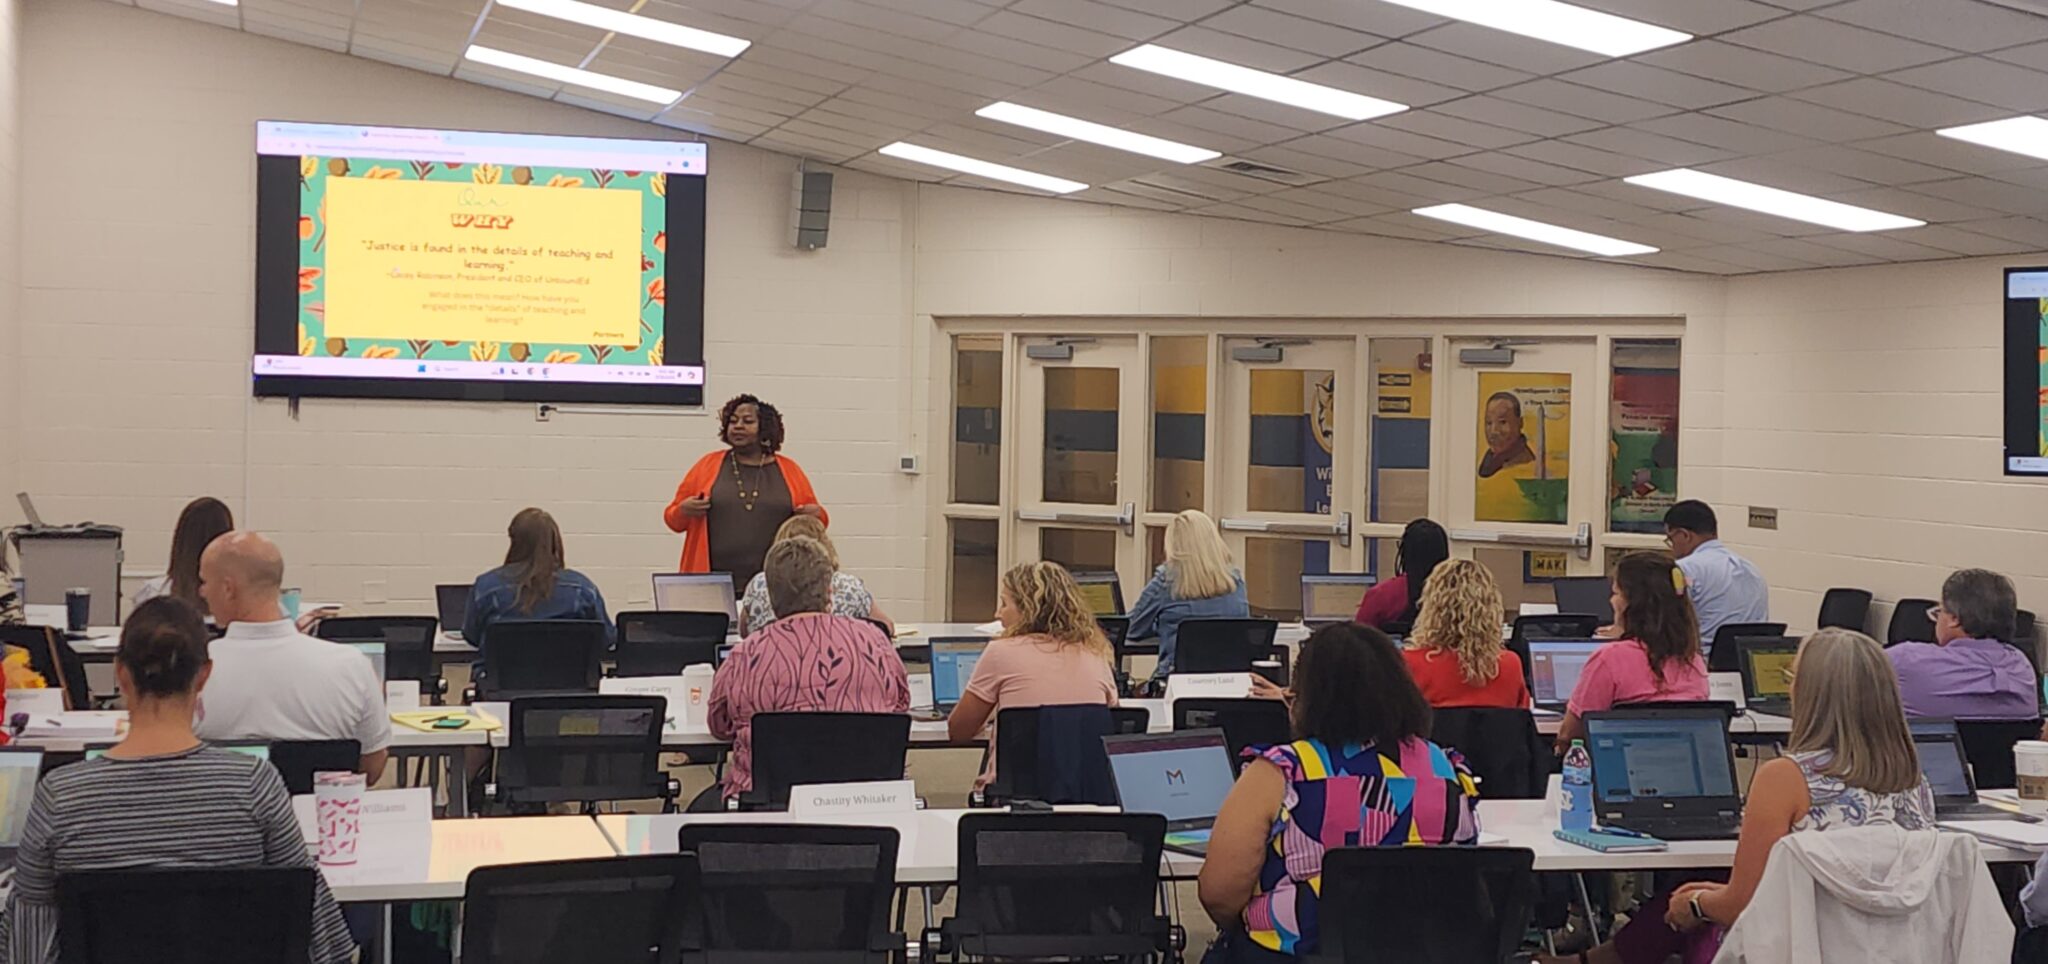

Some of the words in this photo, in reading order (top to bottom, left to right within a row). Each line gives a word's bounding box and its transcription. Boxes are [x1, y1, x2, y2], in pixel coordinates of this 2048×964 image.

[450, 212, 514, 229] WHY
[361, 239, 405, 251] "Justice
[410, 241, 418, 252] is
[423, 241, 453, 253] found
[458, 244, 467, 253] in
[471, 244, 488, 254] the
[493, 245, 528, 256] details
[532, 246, 543, 257] of
[548, 247, 591, 261] teaching
[595, 249, 614, 259] and
[457, 272, 495, 281] President
[498, 274, 512, 282] and
[515, 275, 532, 283] CEO
[534, 275, 543, 283] of
[542, 293, 562, 302] have
[469, 303, 483, 311] the
[522, 305, 531, 313] of
[533, 306, 569, 315] teaching
